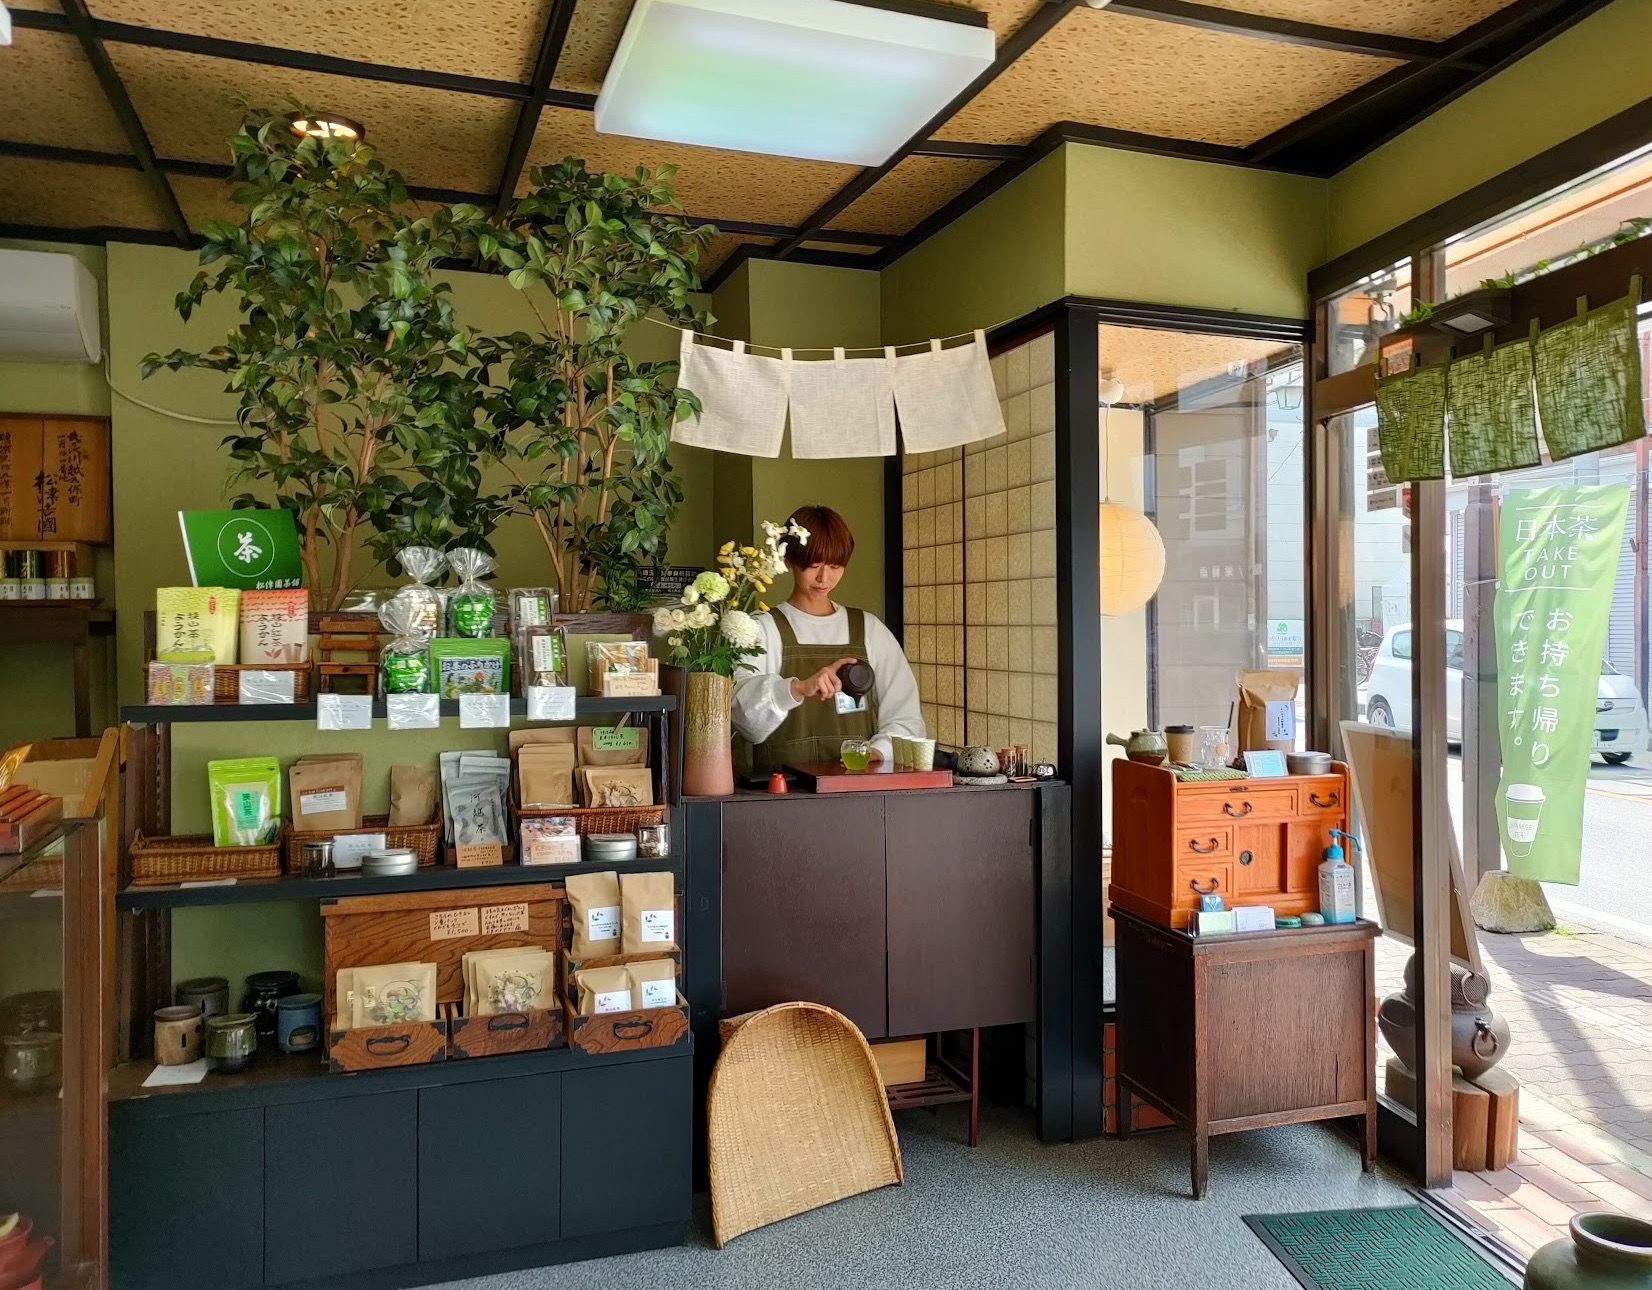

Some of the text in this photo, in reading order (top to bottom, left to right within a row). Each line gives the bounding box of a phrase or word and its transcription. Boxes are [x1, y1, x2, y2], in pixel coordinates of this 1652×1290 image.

[1516, 515, 1598, 542] 日本茶
[234, 531, 262, 564] 茶
[1523, 546, 1579, 564] TAKE
[1523, 564, 1572, 581] OUT
[1507, 609, 1534, 748] できます。
[1531, 608, 1574, 767] お持ち帰り
